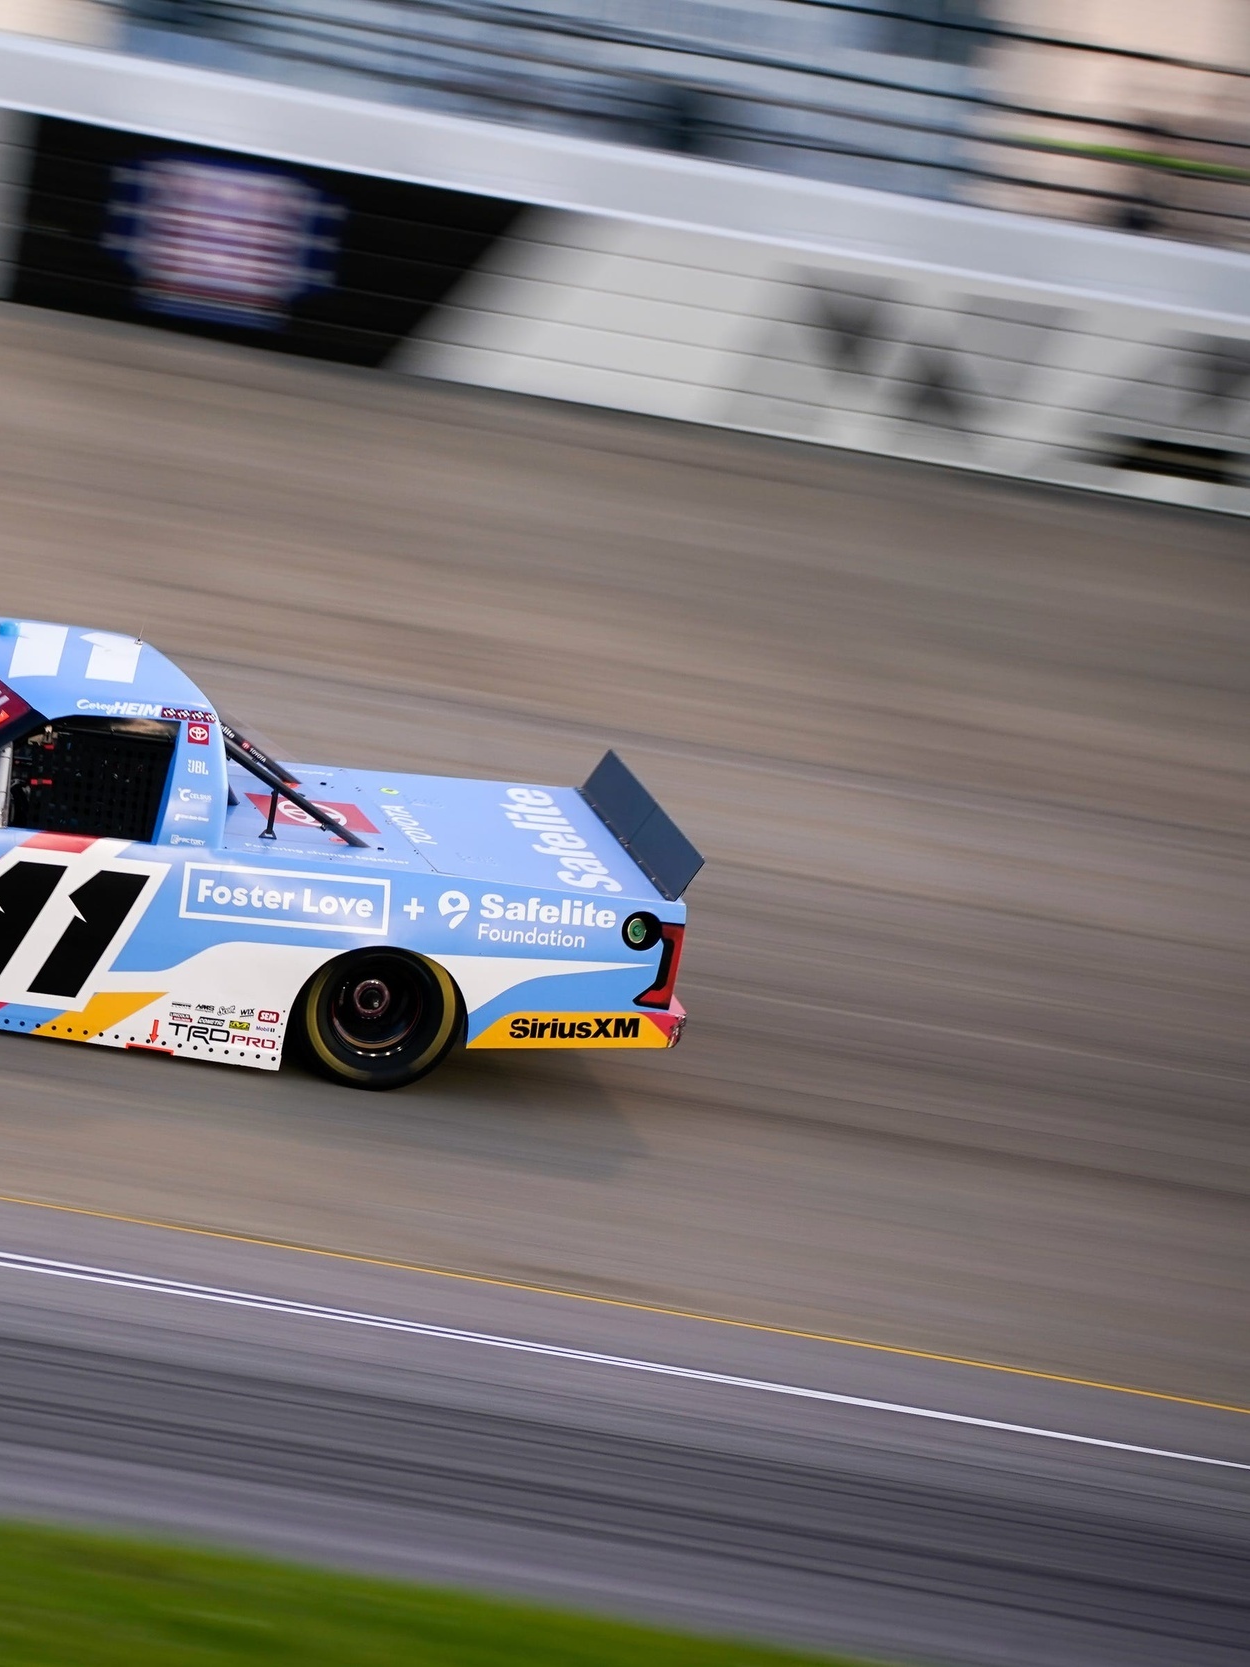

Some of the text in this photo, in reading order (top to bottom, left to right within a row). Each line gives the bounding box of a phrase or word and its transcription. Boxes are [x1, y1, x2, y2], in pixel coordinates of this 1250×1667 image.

[113, 701, 163, 717] HEIM
[249, 748, 267, 763] TOYOTA
[187, 759, 209, 775] JBL
[381, 804, 438, 846] TOYOTA
[498, 787, 623, 893] Safelite
[245, 842, 410, 865] Fostering change together
[197, 878, 295, 910] Foster
[302, 888, 374, 918] Love
[480, 893, 616, 929] Safelite
[478, 923, 586, 948] Foundation
[240, 1008, 255, 1017] WIX
[259, 1012, 277, 1022] SEM
[168, 1022, 276, 1050] TRD PRO
[509, 1017, 640, 1039] SiriusXM
